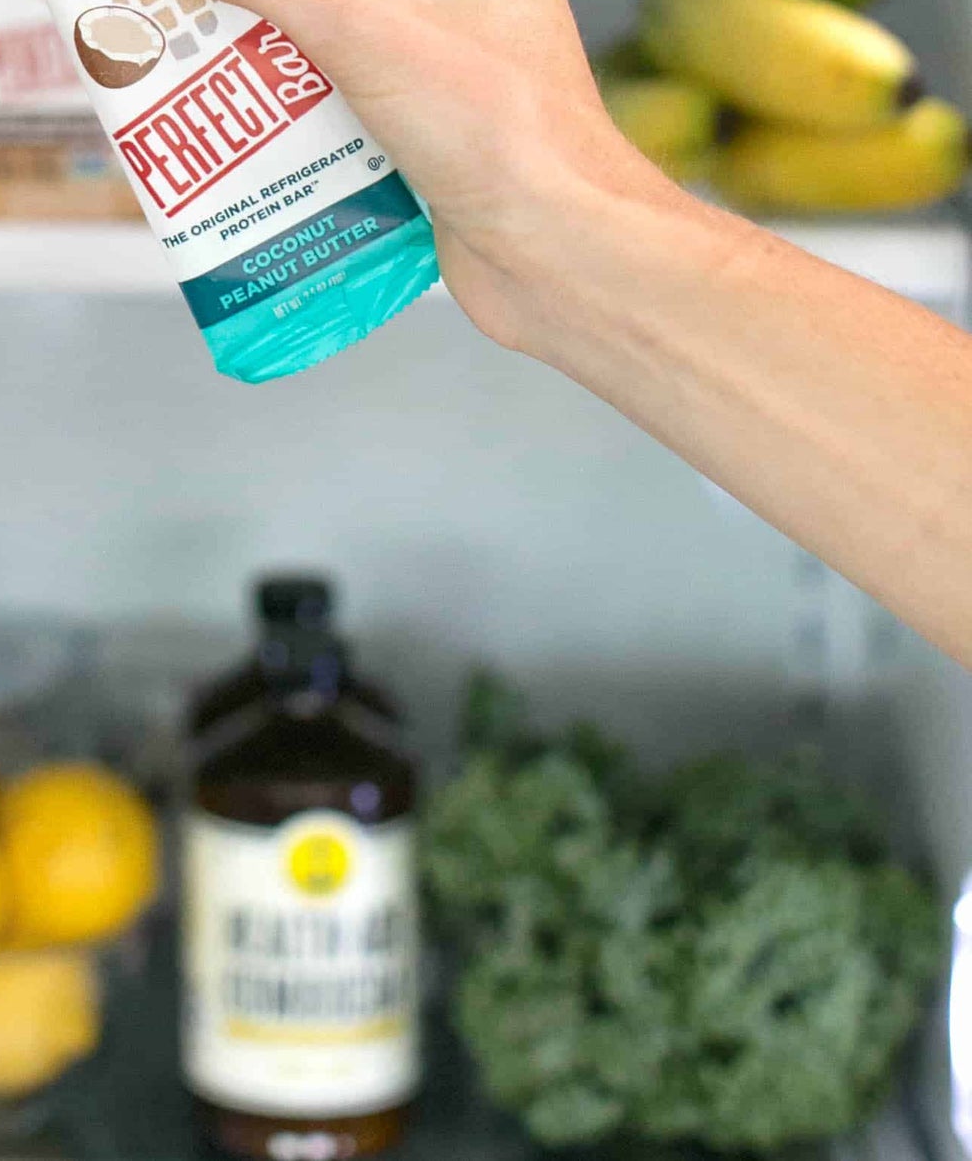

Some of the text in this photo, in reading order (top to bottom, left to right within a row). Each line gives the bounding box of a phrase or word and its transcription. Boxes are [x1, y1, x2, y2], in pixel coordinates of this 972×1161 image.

[119, 56, 278, 209] PERFECT
[258, 21, 328, 105] Bar
[161, 138, 364, 249] THE ORIGINAL REFRIGERATED
[219, 201, 282, 241] PROTEIN
[219, 259, 300, 309] PEANUT
[301, 216, 380, 267] BUTTER
[242, 214, 337, 275] COCONUT
